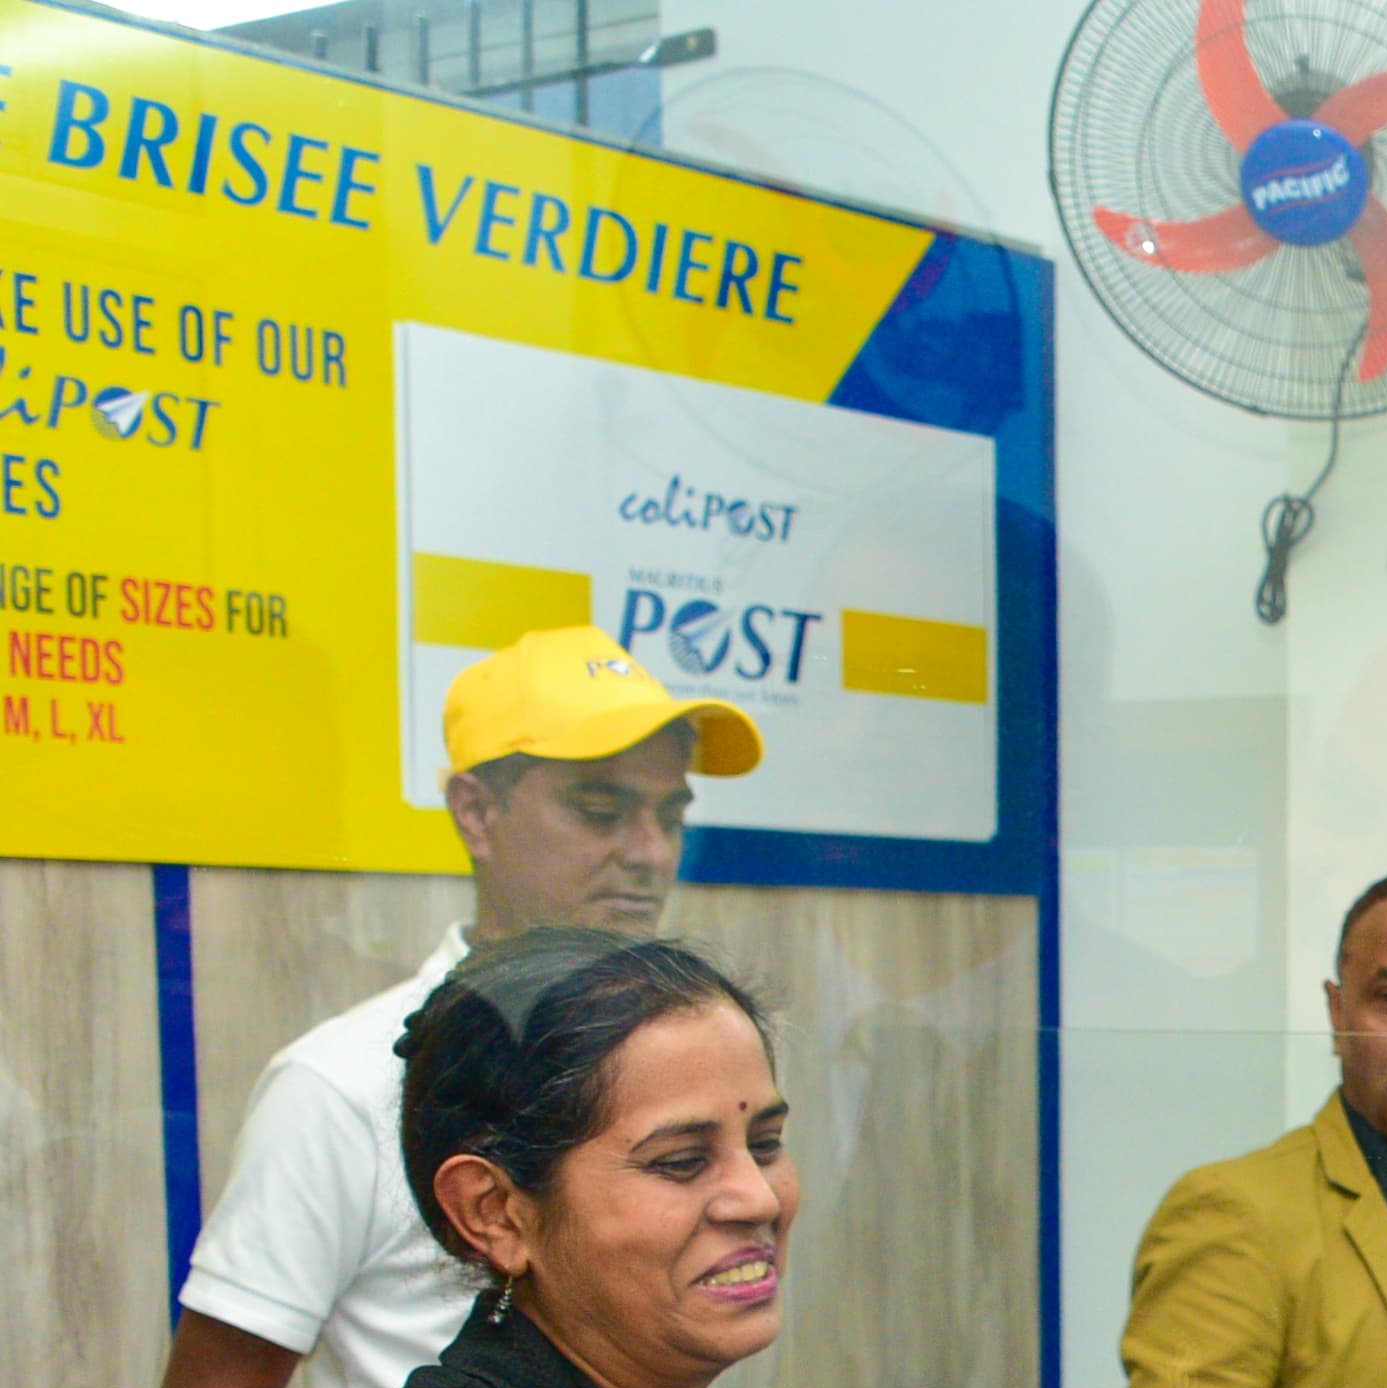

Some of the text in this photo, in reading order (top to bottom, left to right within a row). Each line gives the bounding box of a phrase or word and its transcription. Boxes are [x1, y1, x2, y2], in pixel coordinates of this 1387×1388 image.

[47, 79, 381, 231] BRISEE
[415, 163, 804, 325] VERDIERE
[1252, 154, 1349, 210] PACIFIC
[63, 281, 156, 355] USE
[178, 303, 234, 366] OF
[256, 319, 347, 389] OUR
[66, 571, 108, 618] OF
[120, 577, 217, 631] SIZES
[226, 591, 289, 638] FOR
[618, 587, 823, 684] POST
[9, 631, 124, 685] NEEDS
[50, 698, 77, 747] L,
[87, 700, 125, 743] XL
